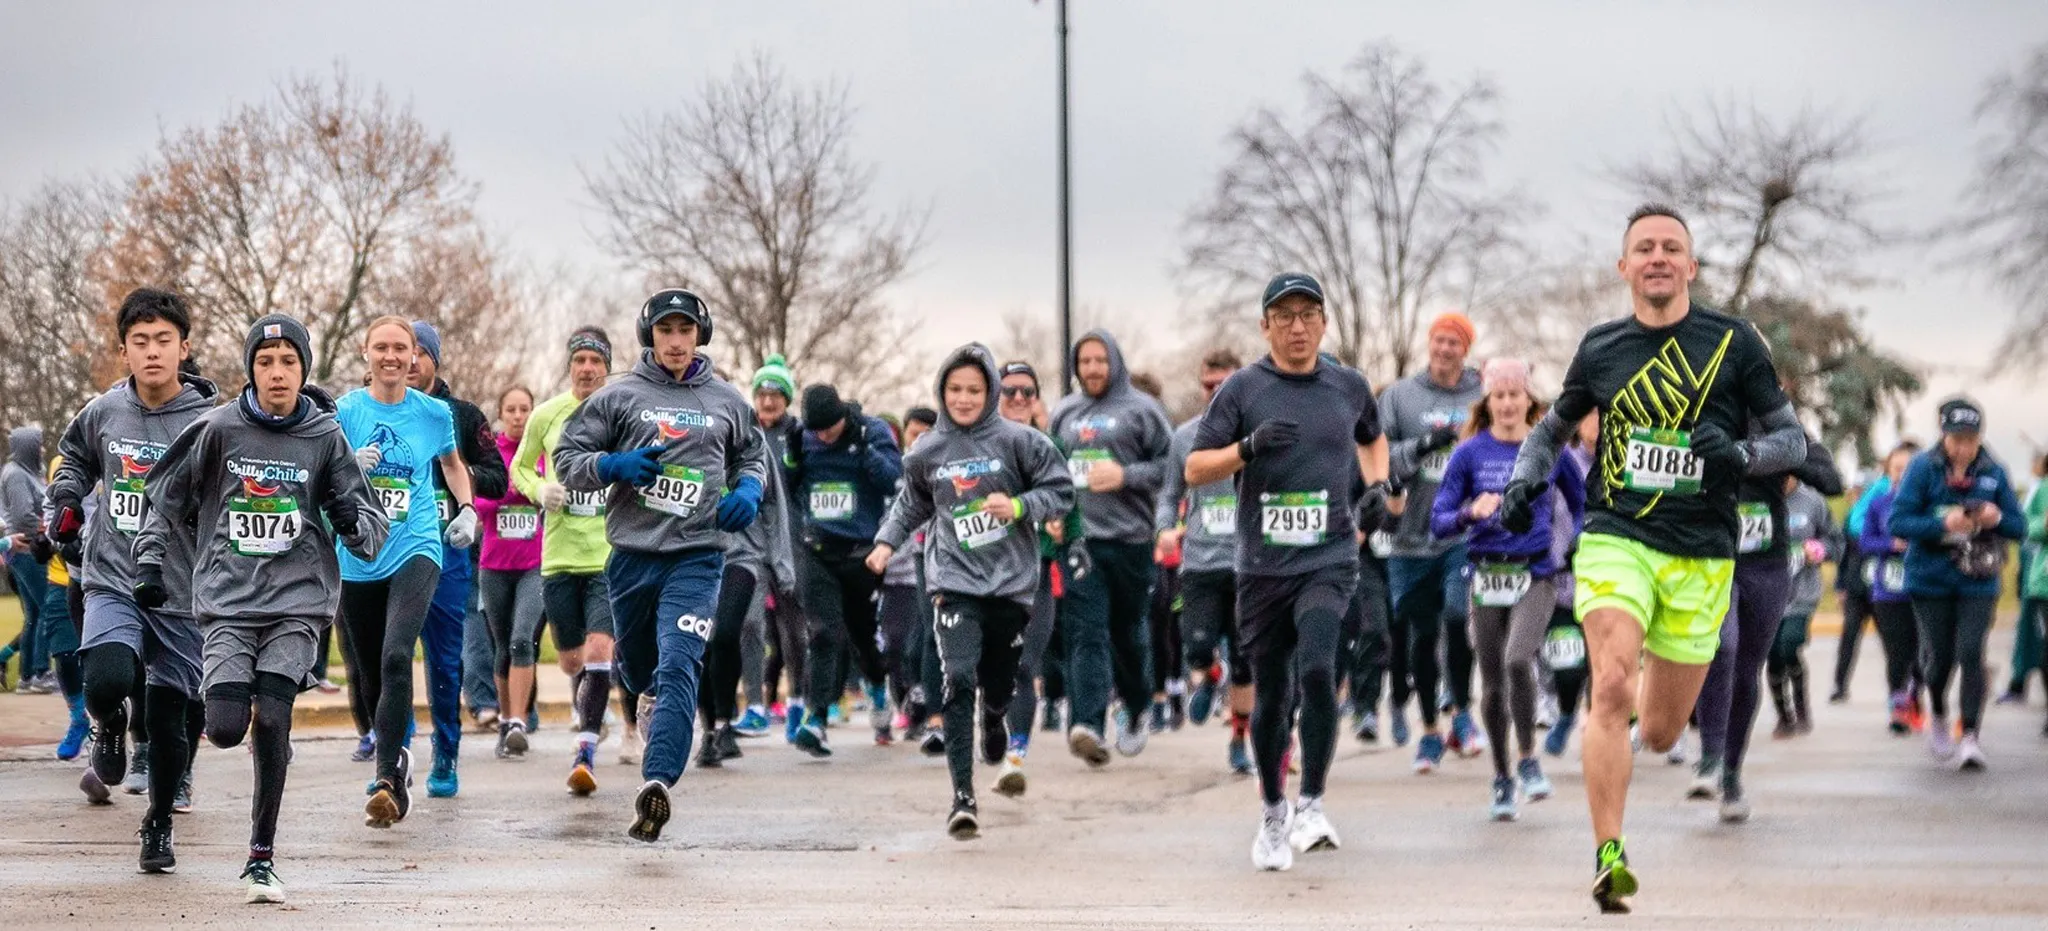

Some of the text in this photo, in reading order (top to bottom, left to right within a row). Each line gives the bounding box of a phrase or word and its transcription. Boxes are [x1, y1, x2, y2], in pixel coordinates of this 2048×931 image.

[1631, 443, 1698, 477] 3088
[367, 466, 411, 478] MPEDE
[114, 492, 140, 517] 30
[376, 488, 406, 509] 62
[813, 493, 849, 509] 3007
[236, 513, 297, 539] 3074
[499, 514, 536, 530] 3009
[958, 510, 1009, 539] 302
[1268, 508, 1322, 531] 2993
[1744, 517, 1768, 537] 24
